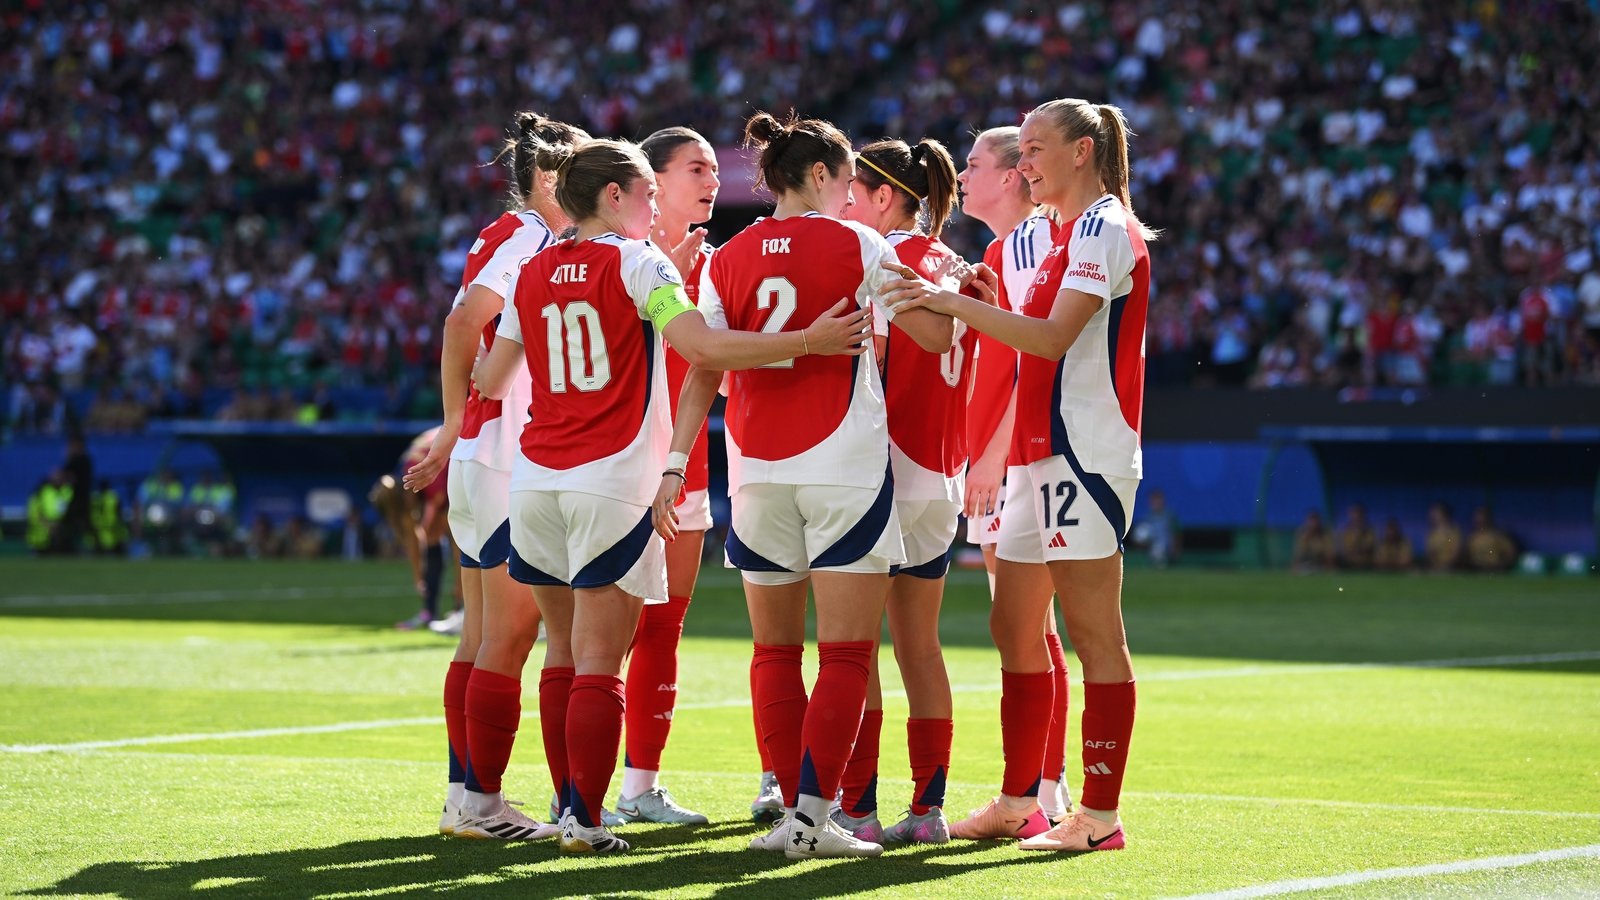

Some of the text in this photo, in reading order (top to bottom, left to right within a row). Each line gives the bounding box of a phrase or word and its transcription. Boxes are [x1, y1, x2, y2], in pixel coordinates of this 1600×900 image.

[762, 237, 792, 256] FOX
[1078, 261, 1101, 272] VISIT
[1067, 269, 1106, 283] RWANDA
[757, 276, 797, 369] 2
[541, 301, 612, 393] 10
[1040, 480, 1080, 529] 12
[657, 683, 678, 692] AF
[1084, 739, 1117, 750] AFC
